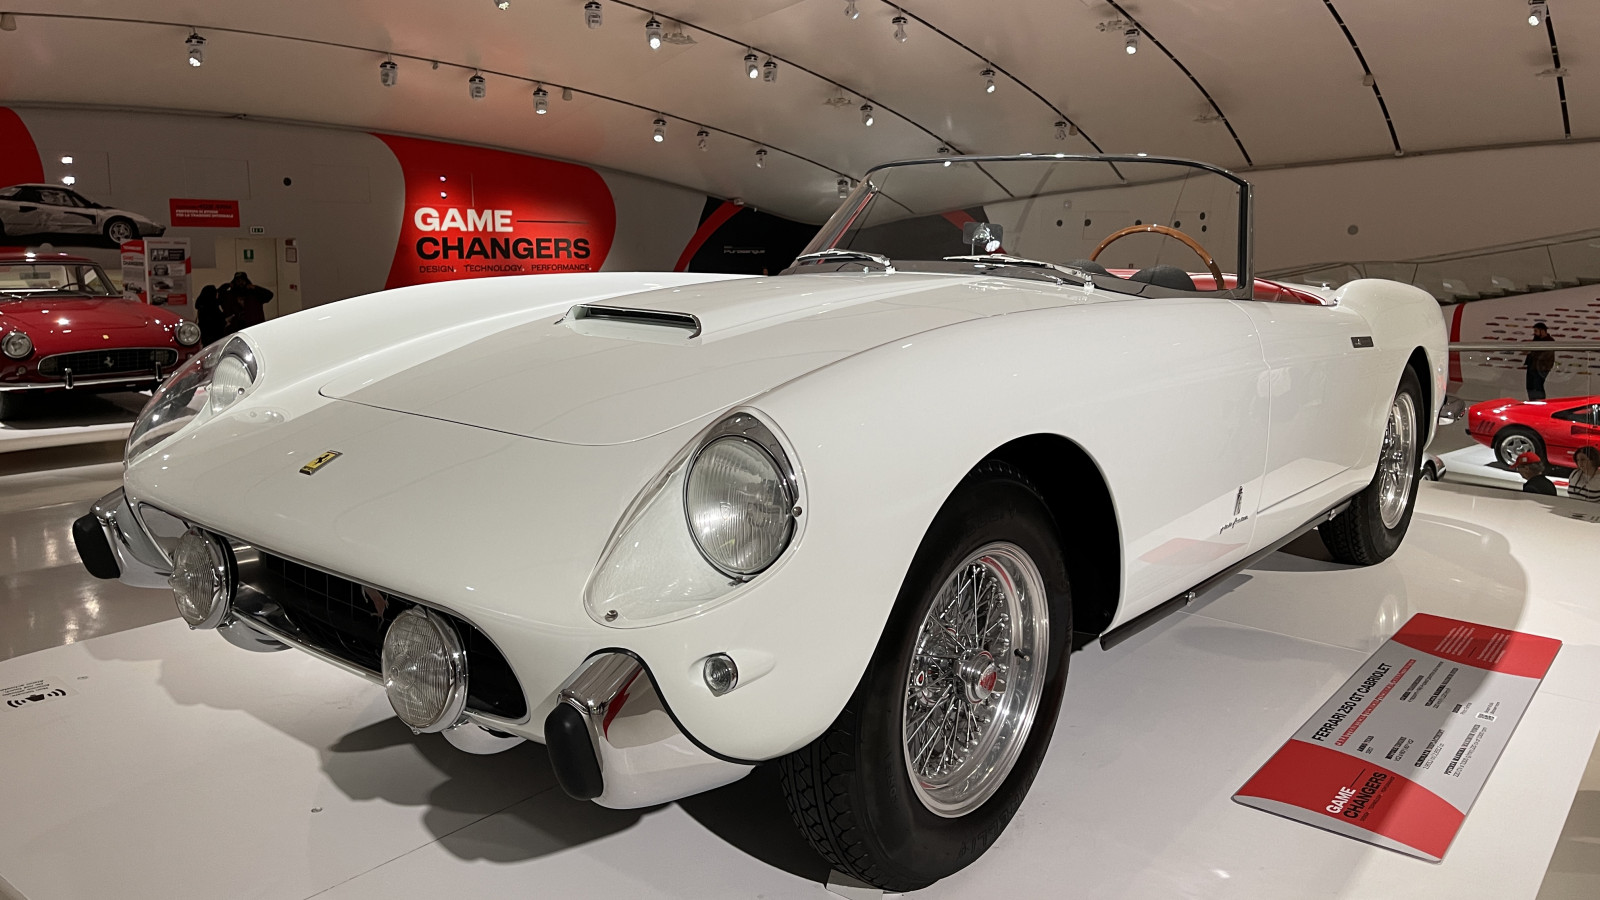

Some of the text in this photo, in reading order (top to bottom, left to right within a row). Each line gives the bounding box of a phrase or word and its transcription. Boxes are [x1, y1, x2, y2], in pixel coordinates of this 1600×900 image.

[414, 207, 513, 232] GAME
[416, 237, 591, 260] CHANGERS
[531, 264, 592, 272] PERFORMANCE.
[1312, 663, 1392, 741] FERRARI 250 GT CABRIOLET
[1325, 786, 1356, 814] GAME
[1343, 772, 1387, 818] CHANGERS
